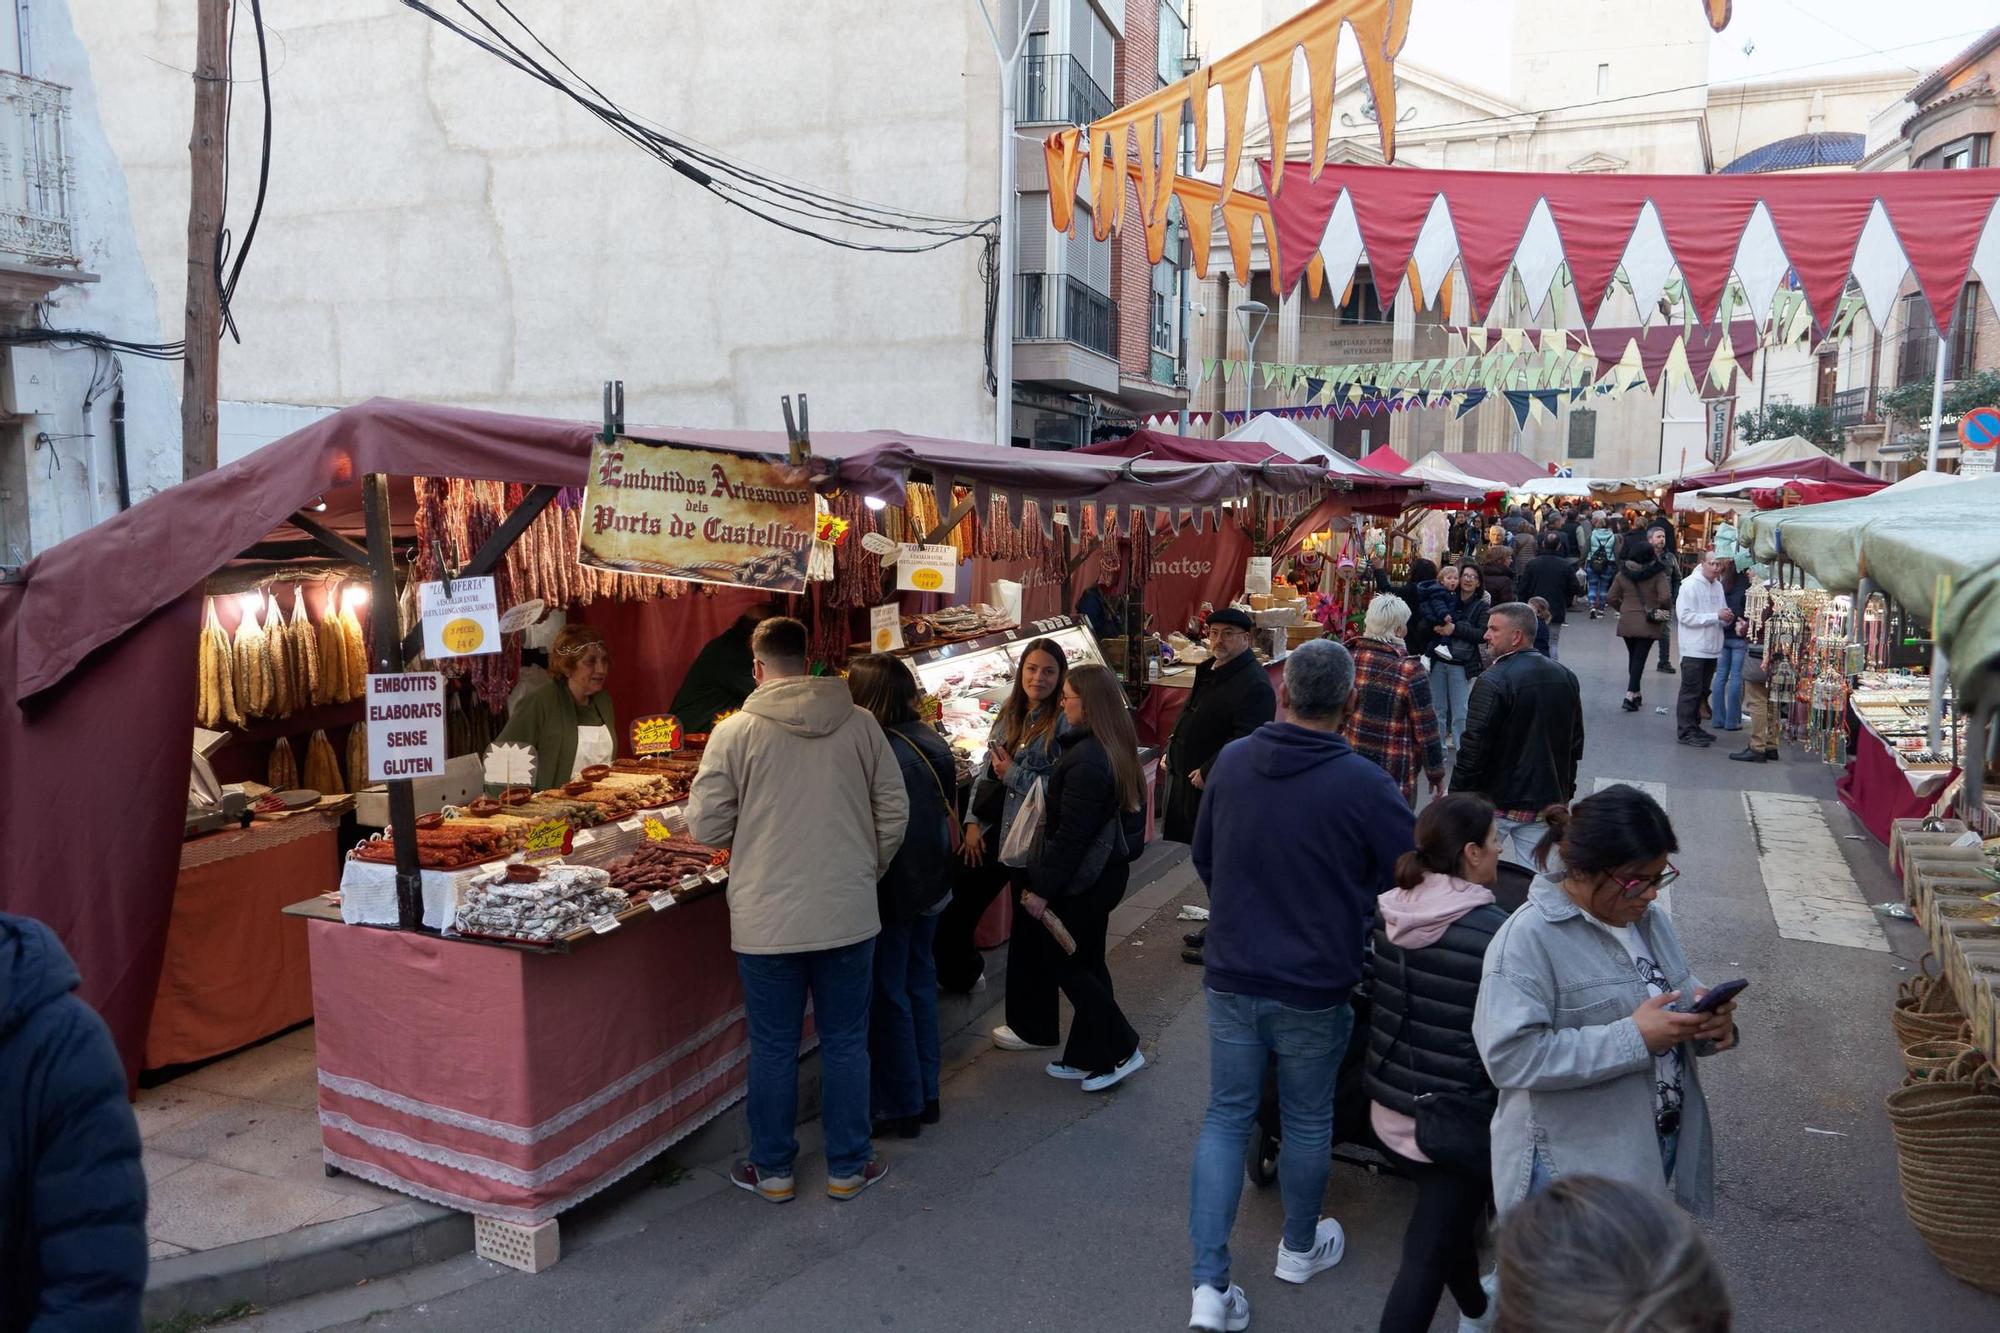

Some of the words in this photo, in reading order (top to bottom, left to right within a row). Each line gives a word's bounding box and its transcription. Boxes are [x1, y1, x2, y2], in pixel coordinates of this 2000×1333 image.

[1343, 347, 1393, 355] INTERNACIONA
[599, 451, 706, 495] Embutidos
[710, 463, 810, 504] Artesanos
[685, 499, 709, 513] dels
[592, 503, 661, 535] Ports
[668, 513, 697, 540] de
[703, 516, 810, 550] Castellón
[374, 675, 437, 693] EMBOTITS
[370, 702, 442, 721] ELABORATS
[387, 730, 428, 748] SENSE
[383, 757, 433, 776] GLUTEN
